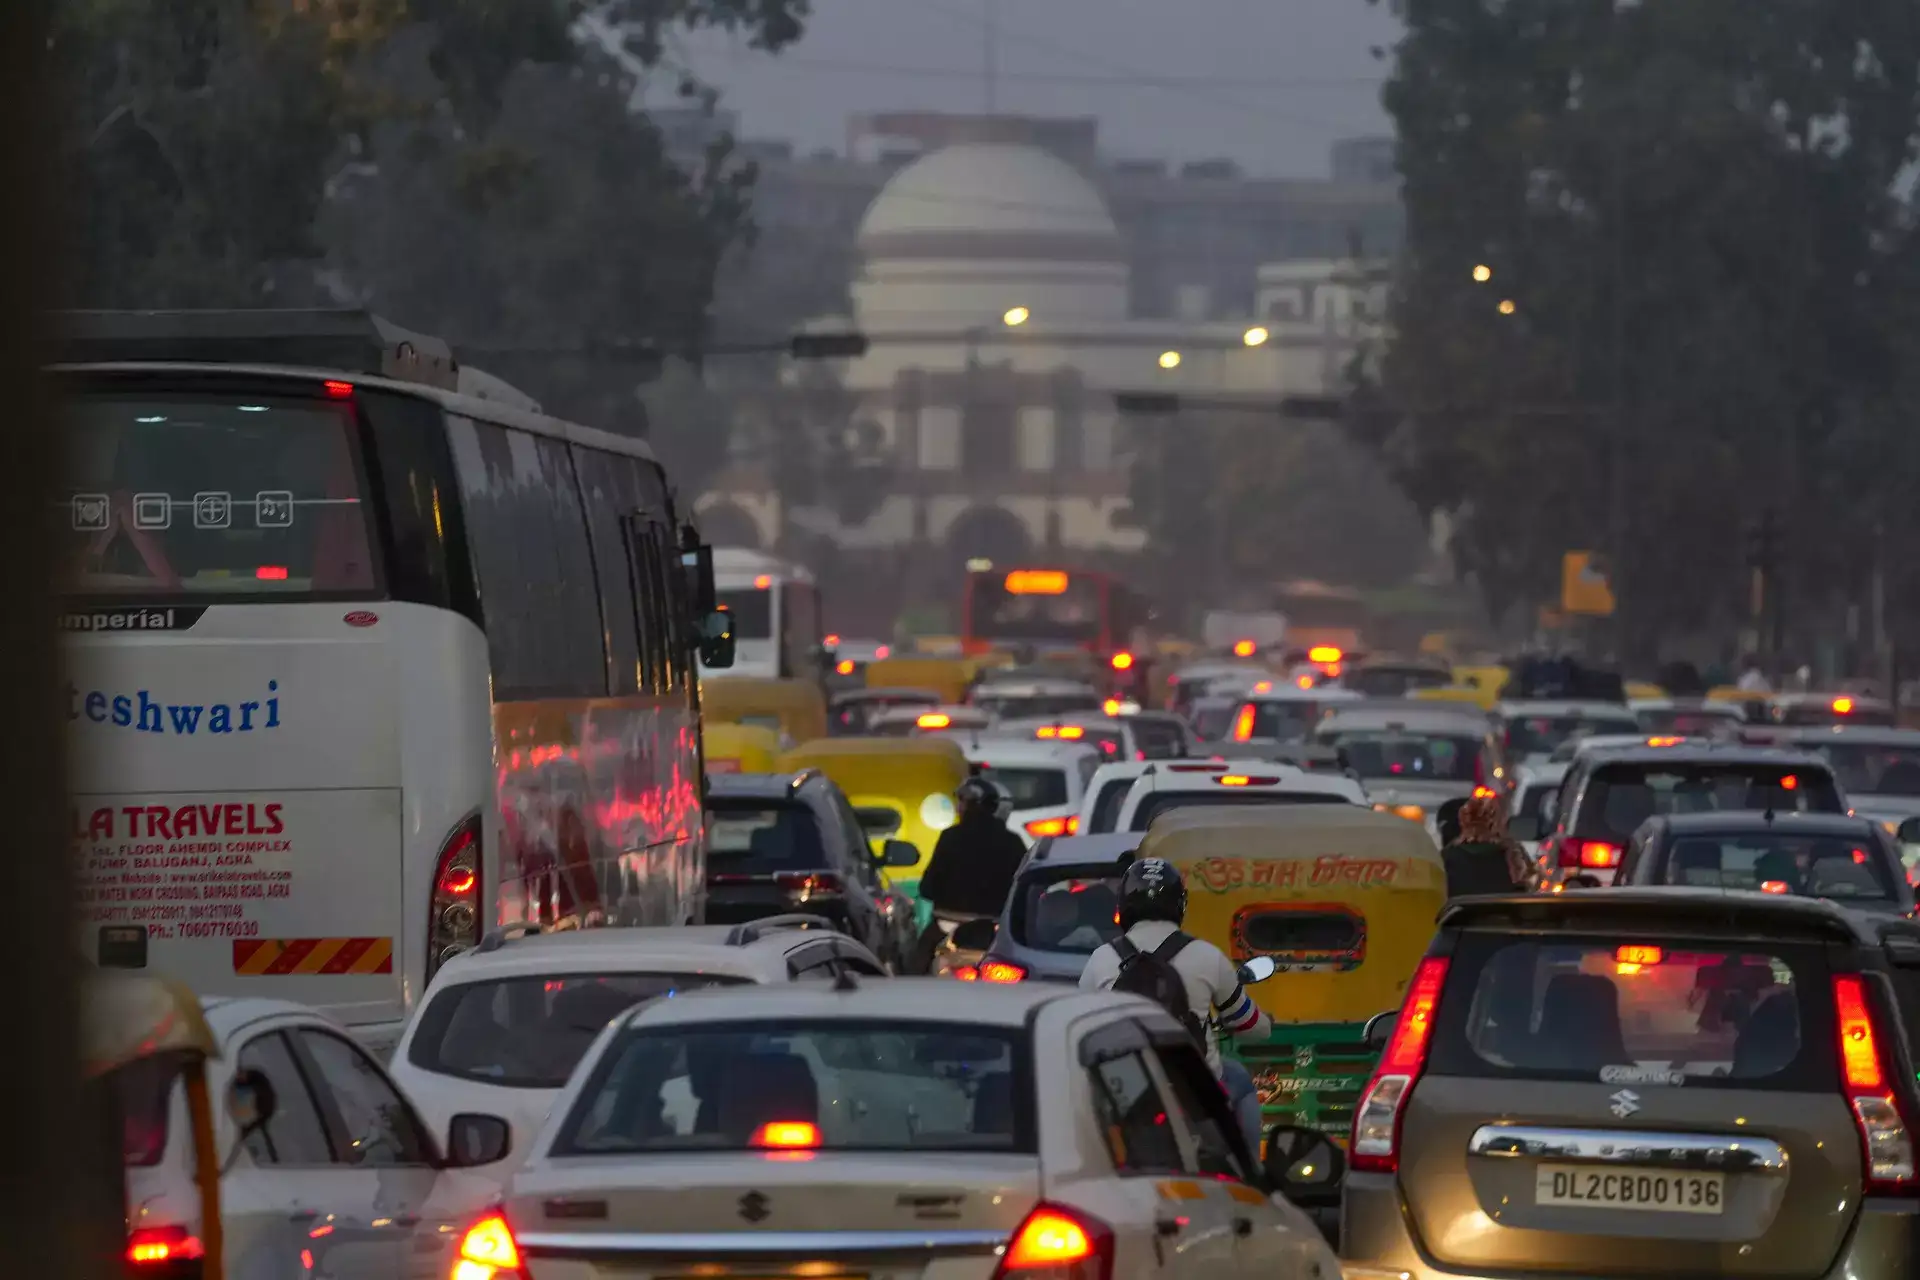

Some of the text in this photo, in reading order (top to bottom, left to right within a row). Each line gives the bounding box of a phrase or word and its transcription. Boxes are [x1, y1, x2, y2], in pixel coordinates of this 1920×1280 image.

[122, 804, 284, 840] TRAVELS
[119, 845, 164, 856] FLOOR
[226, 840, 292, 853] COMPLEX
[216, 854, 253, 867] AGRA
[1553, 1171, 1720, 1207] DL2CBD0136
